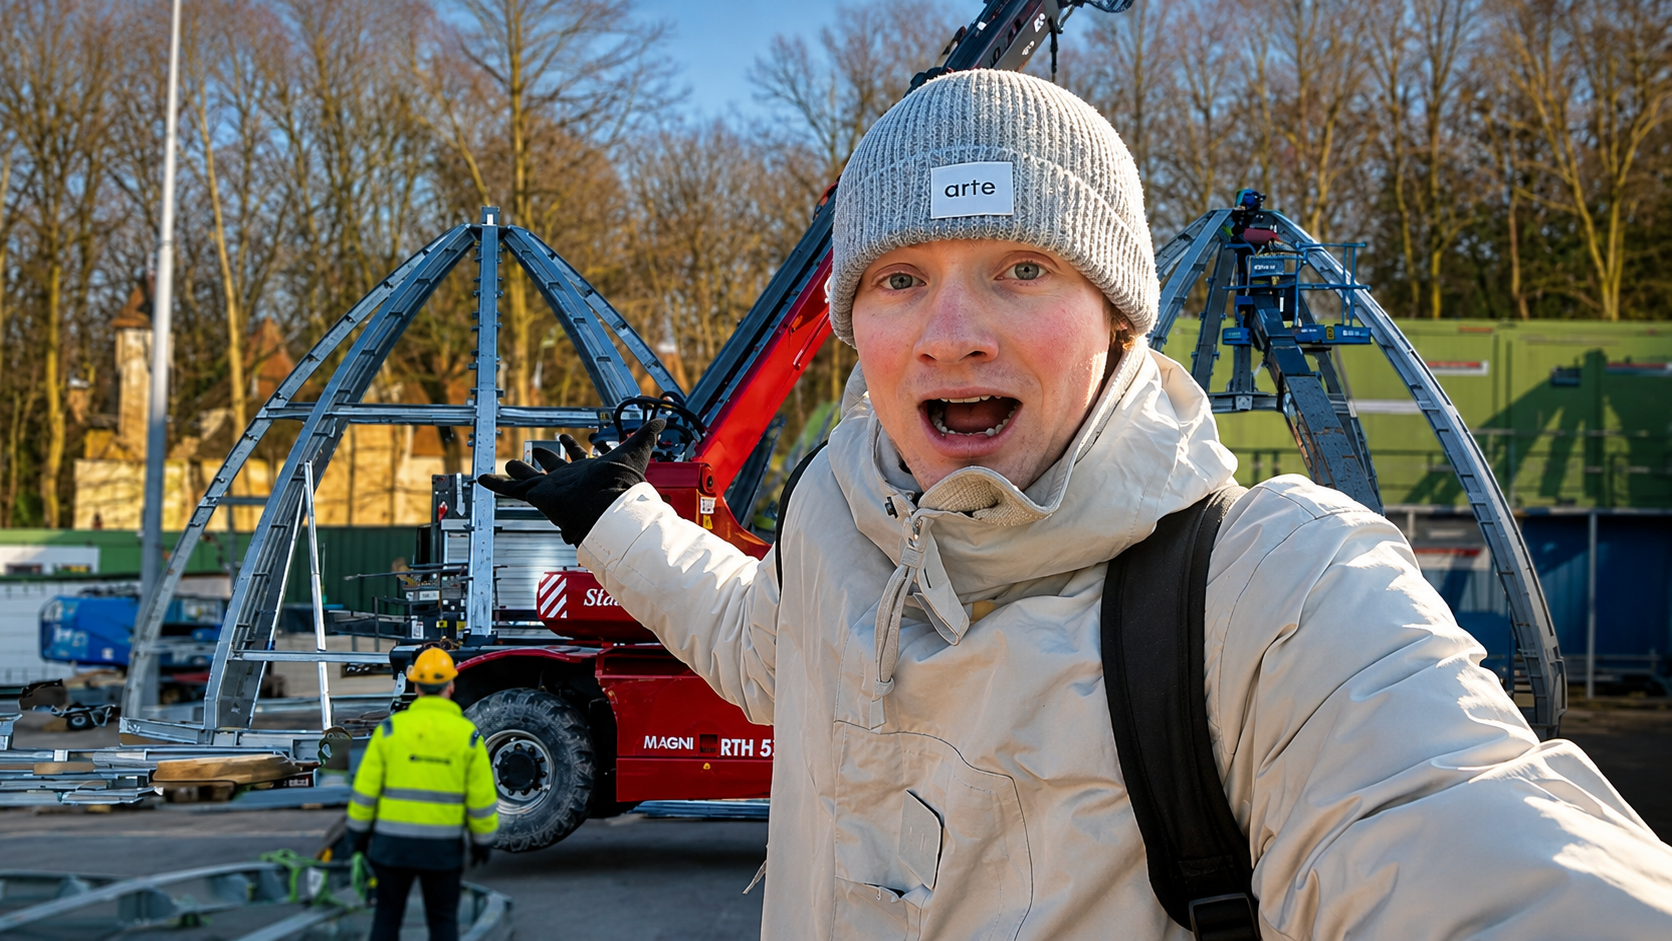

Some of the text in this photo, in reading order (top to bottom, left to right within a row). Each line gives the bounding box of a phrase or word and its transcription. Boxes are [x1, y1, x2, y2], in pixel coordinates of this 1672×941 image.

[944, 179, 996, 198] arte
[643, 735, 774, 757] MAGNI RTH 5
